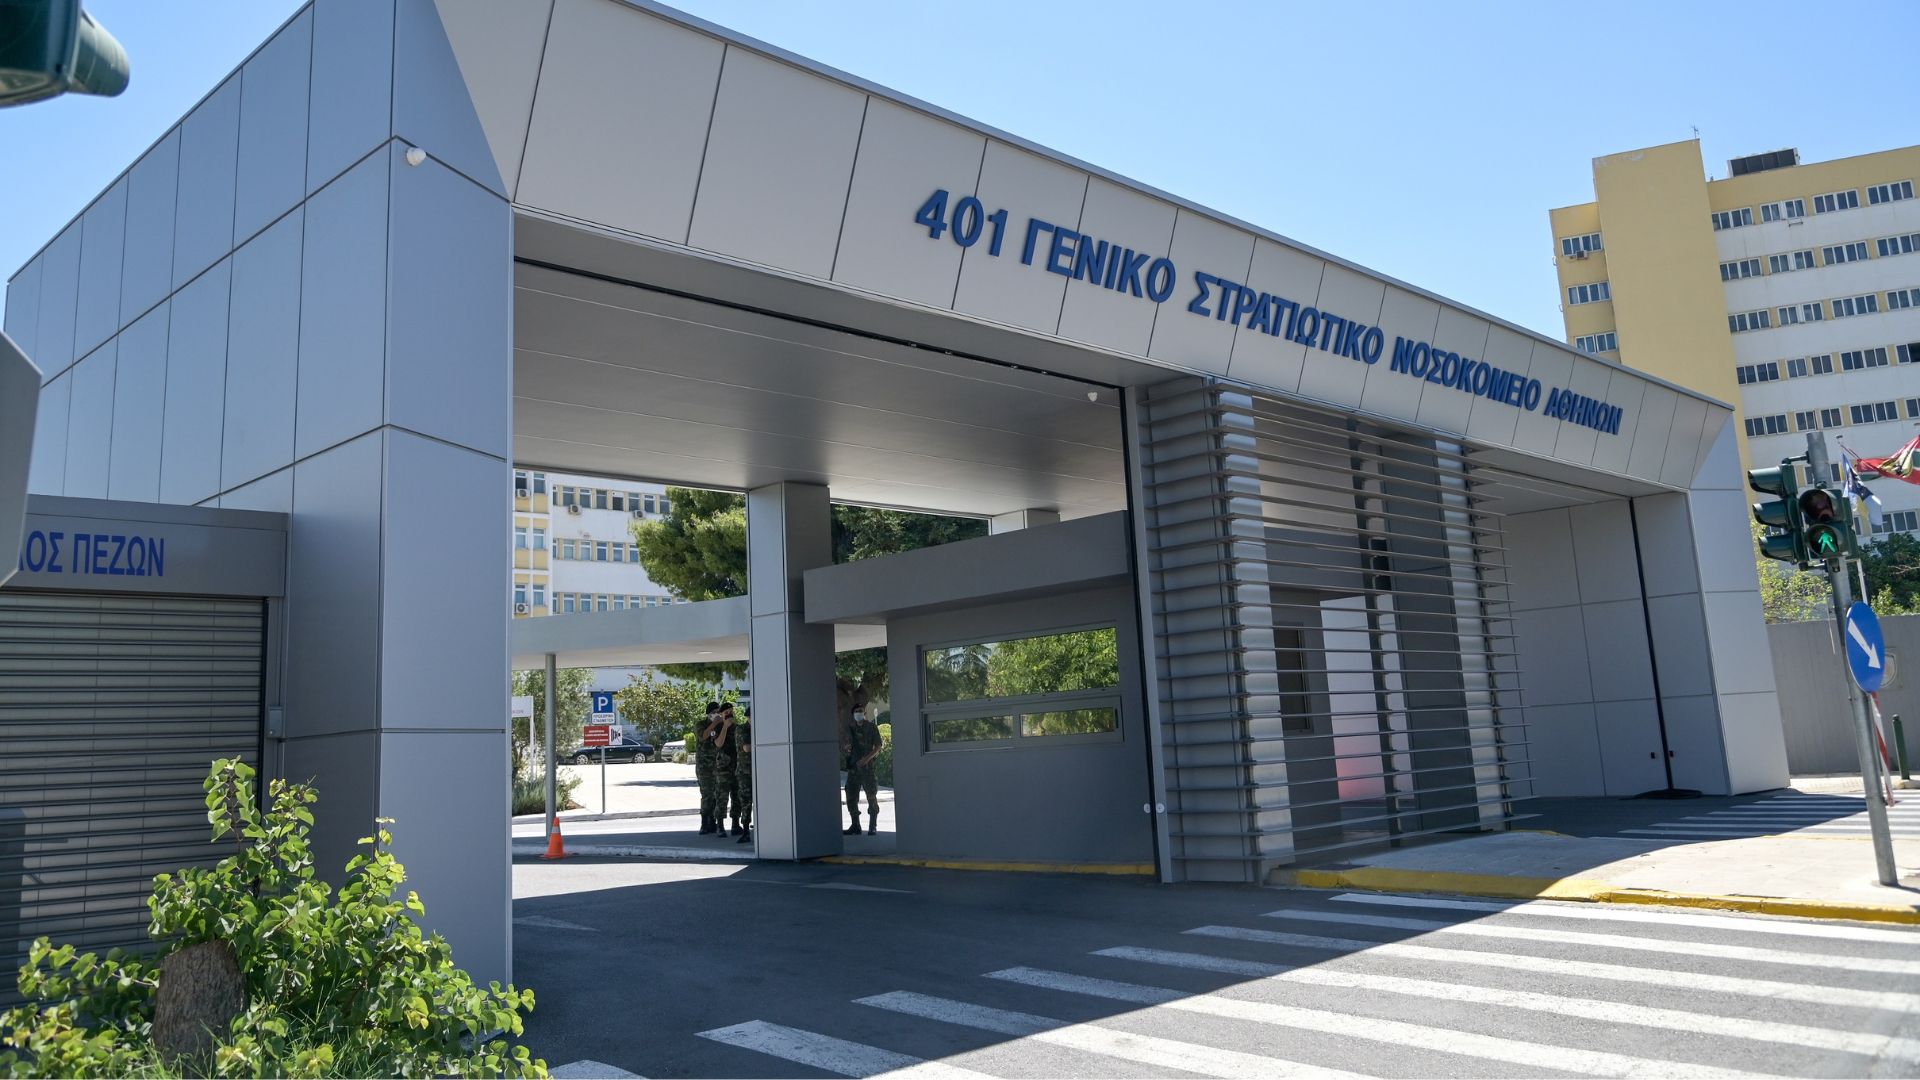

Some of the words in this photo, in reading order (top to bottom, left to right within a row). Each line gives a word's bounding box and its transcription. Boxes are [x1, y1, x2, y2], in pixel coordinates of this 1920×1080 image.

[915, 189, 1008, 257] 401
[1021, 217, 1176, 303] ΓΕΝΙΚΟ
[1187, 271, 1384, 365] ΣΤΡΑΤΙΩΤΙΚΟ
[1390, 336, 1541, 411] ΝΟΣΟΚΟΜΕΙΟ
[1543, 387, 1623, 436] ΑΘΗΝΩΝ
[19, 530, 64, 573] ΟΣ
[72, 533, 164, 577] ΠΕΖΩΝ
[598, 696, 608, 711] P
